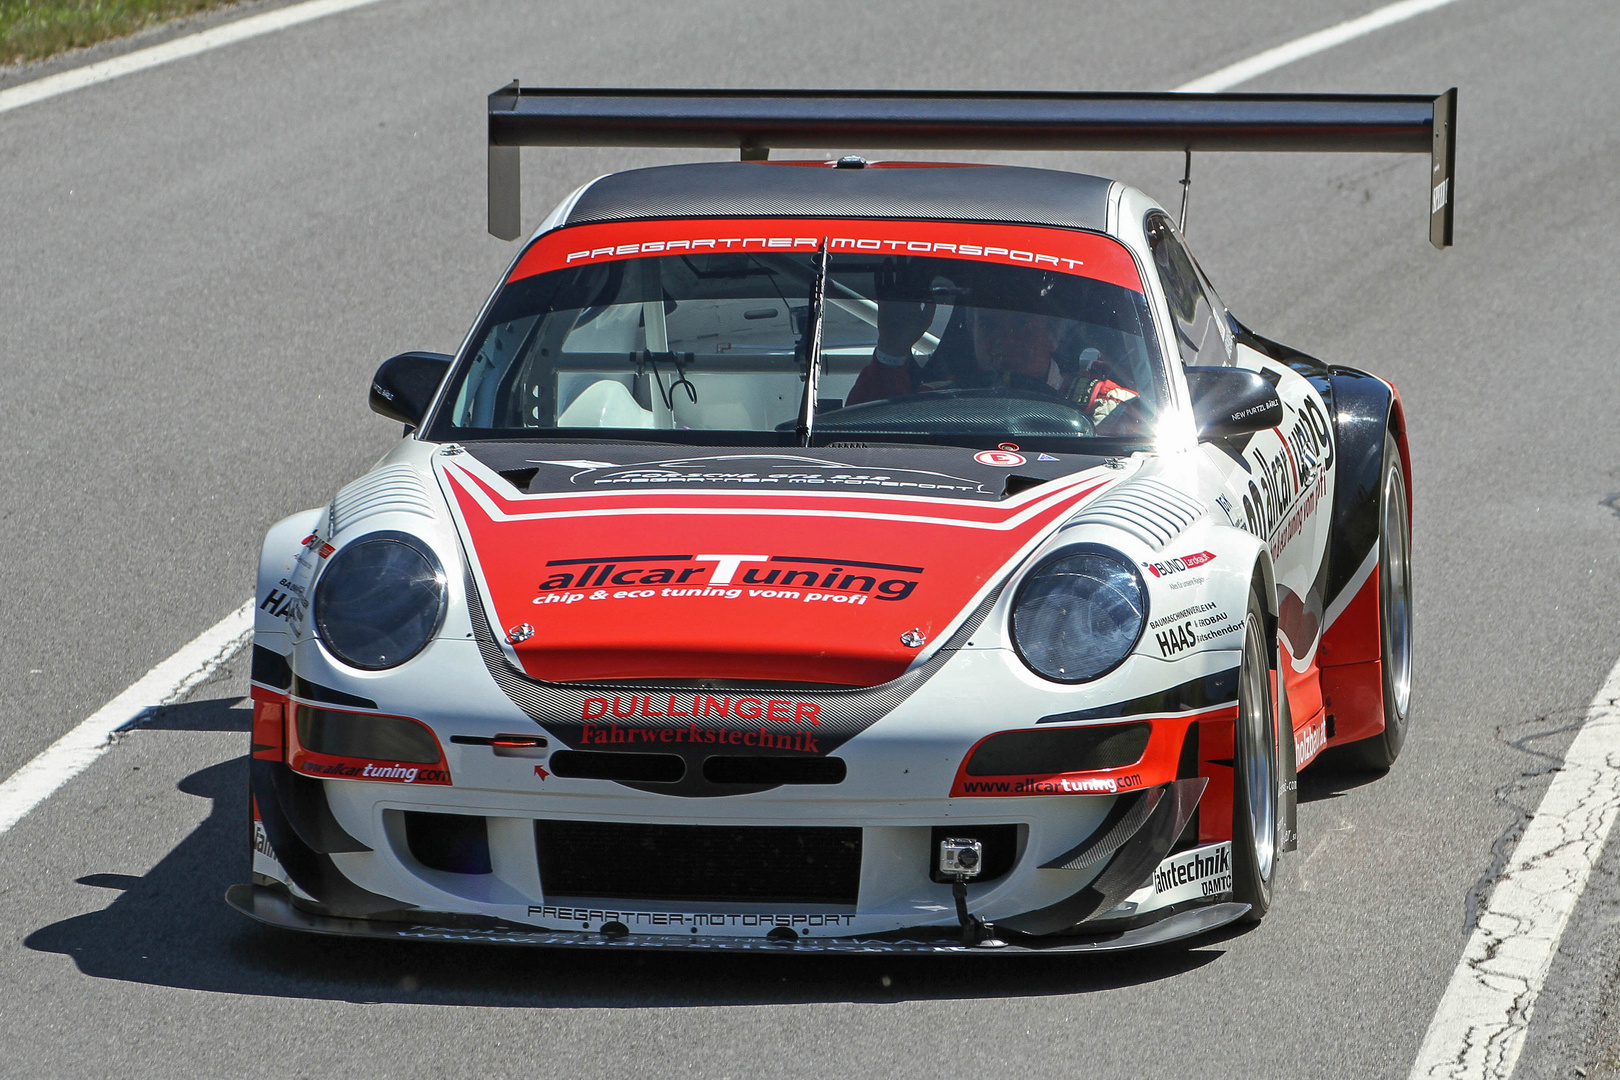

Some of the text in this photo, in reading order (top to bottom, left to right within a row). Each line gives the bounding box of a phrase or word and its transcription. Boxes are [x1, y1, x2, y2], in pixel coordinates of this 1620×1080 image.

[566, 237, 1084, 269] PREGARTNER MOTORSPORT
[789, 478, 973, 491] MOTORSPORT
[1155, 557, 1186, 576] BUND
[532, 586, 868, 606] chip & eco tuning vom profi
[1155, 621, 1197, 657] HAAS
[581, 695, 822, 726] DULLINGER
[580, 723, 819, 753] Fahrwerkstechnik
[963, 773, 1142, 793] www.allcartuning.com
[527, 905, 856, 927] PREGARTNER-MOTORSPORT
